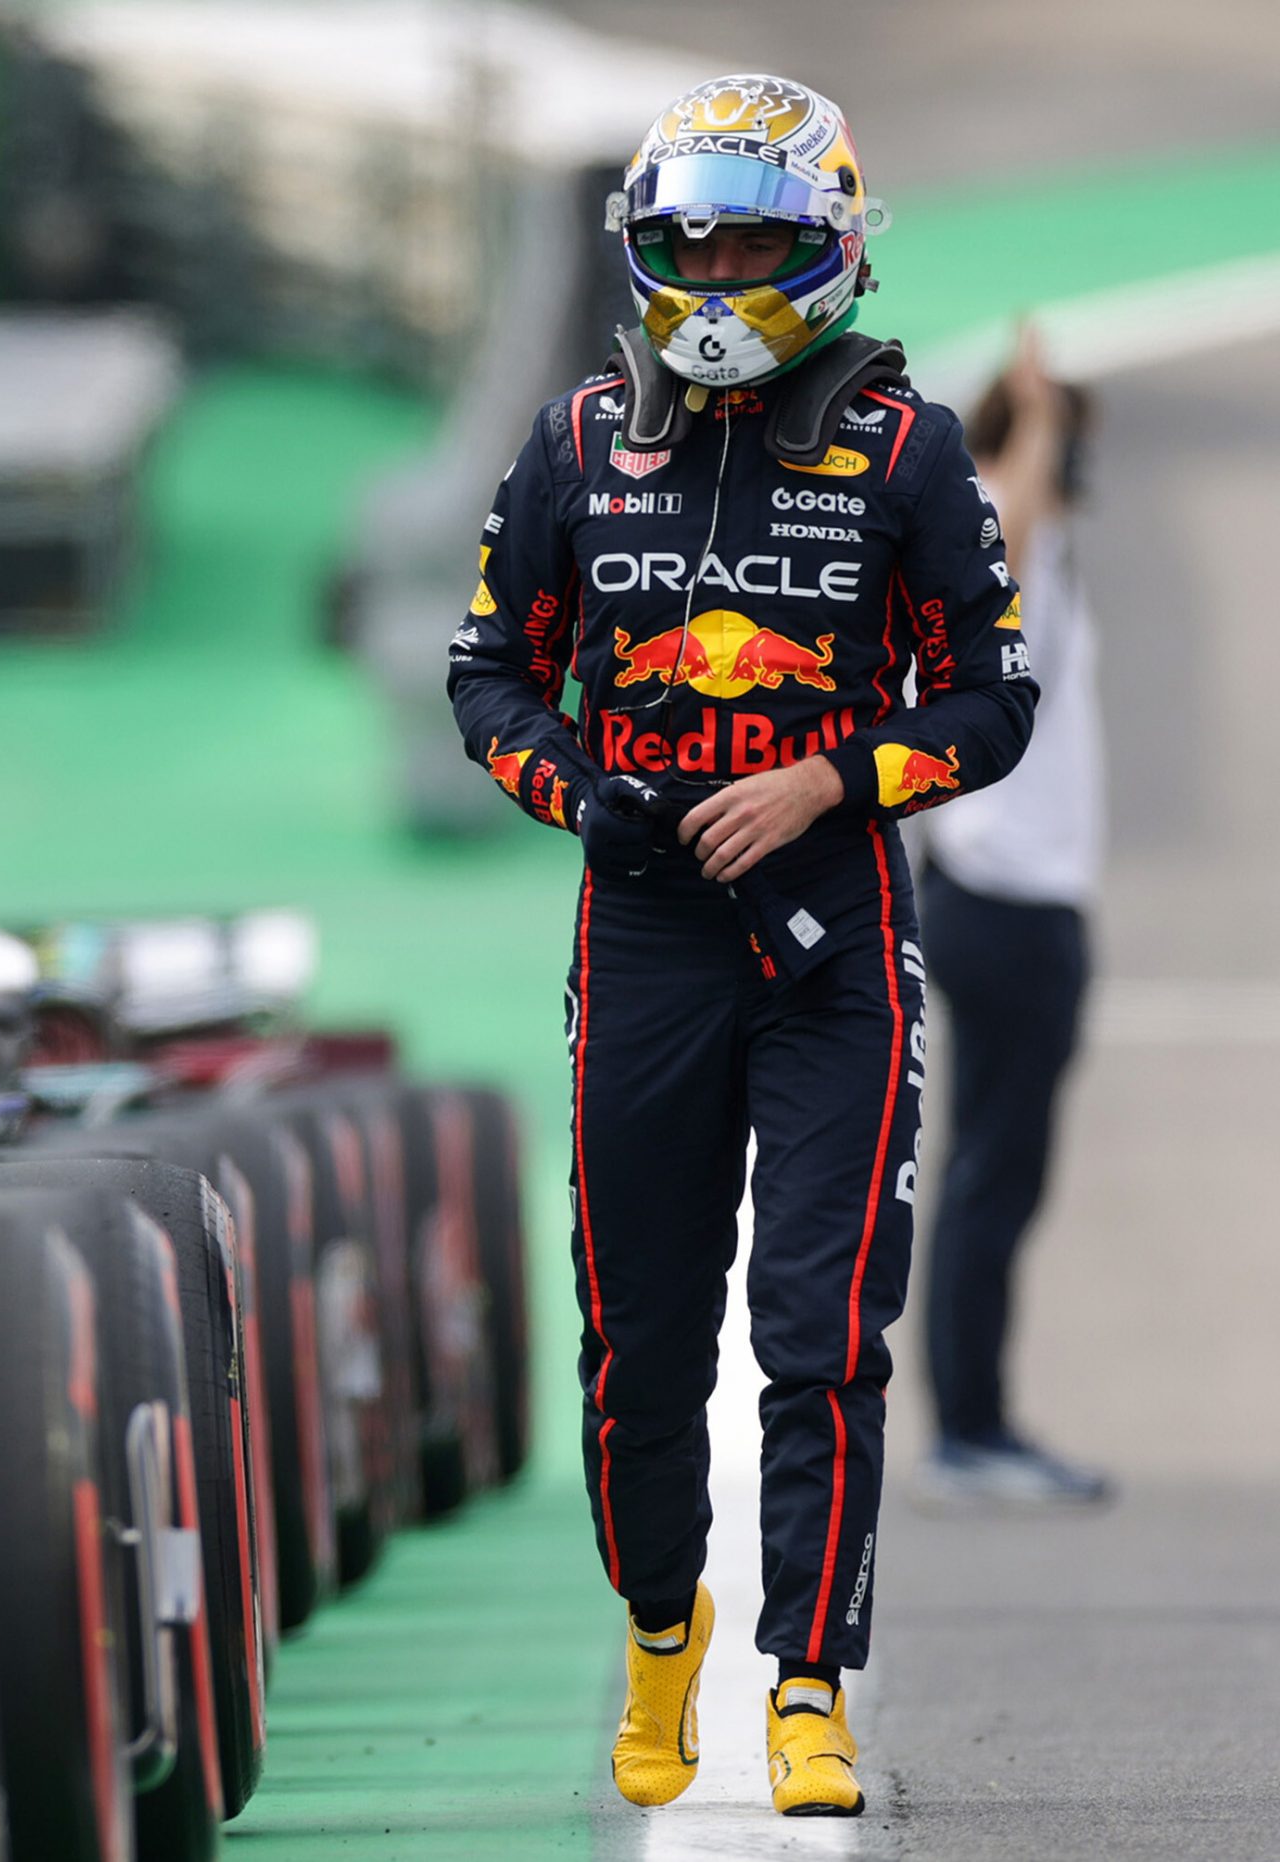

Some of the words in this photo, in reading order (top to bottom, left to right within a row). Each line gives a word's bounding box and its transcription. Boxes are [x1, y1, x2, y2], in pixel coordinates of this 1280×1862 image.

[650, 136, 781, 165] ORACLE
[691, 365, 740, 381] Gate
[613, 452, 668, 474] HEUER
[822, 454, 857, 470] UCH
[589, 492, 655, 515] Mobil
[770, 522, 863, 542] HONDA
[591, 552, 862, 601] ORACLE
[599, 707, 716, 773] Red
[730, 707, 856, 775] Bull
[846, 1532, 874, 1625] sparco
